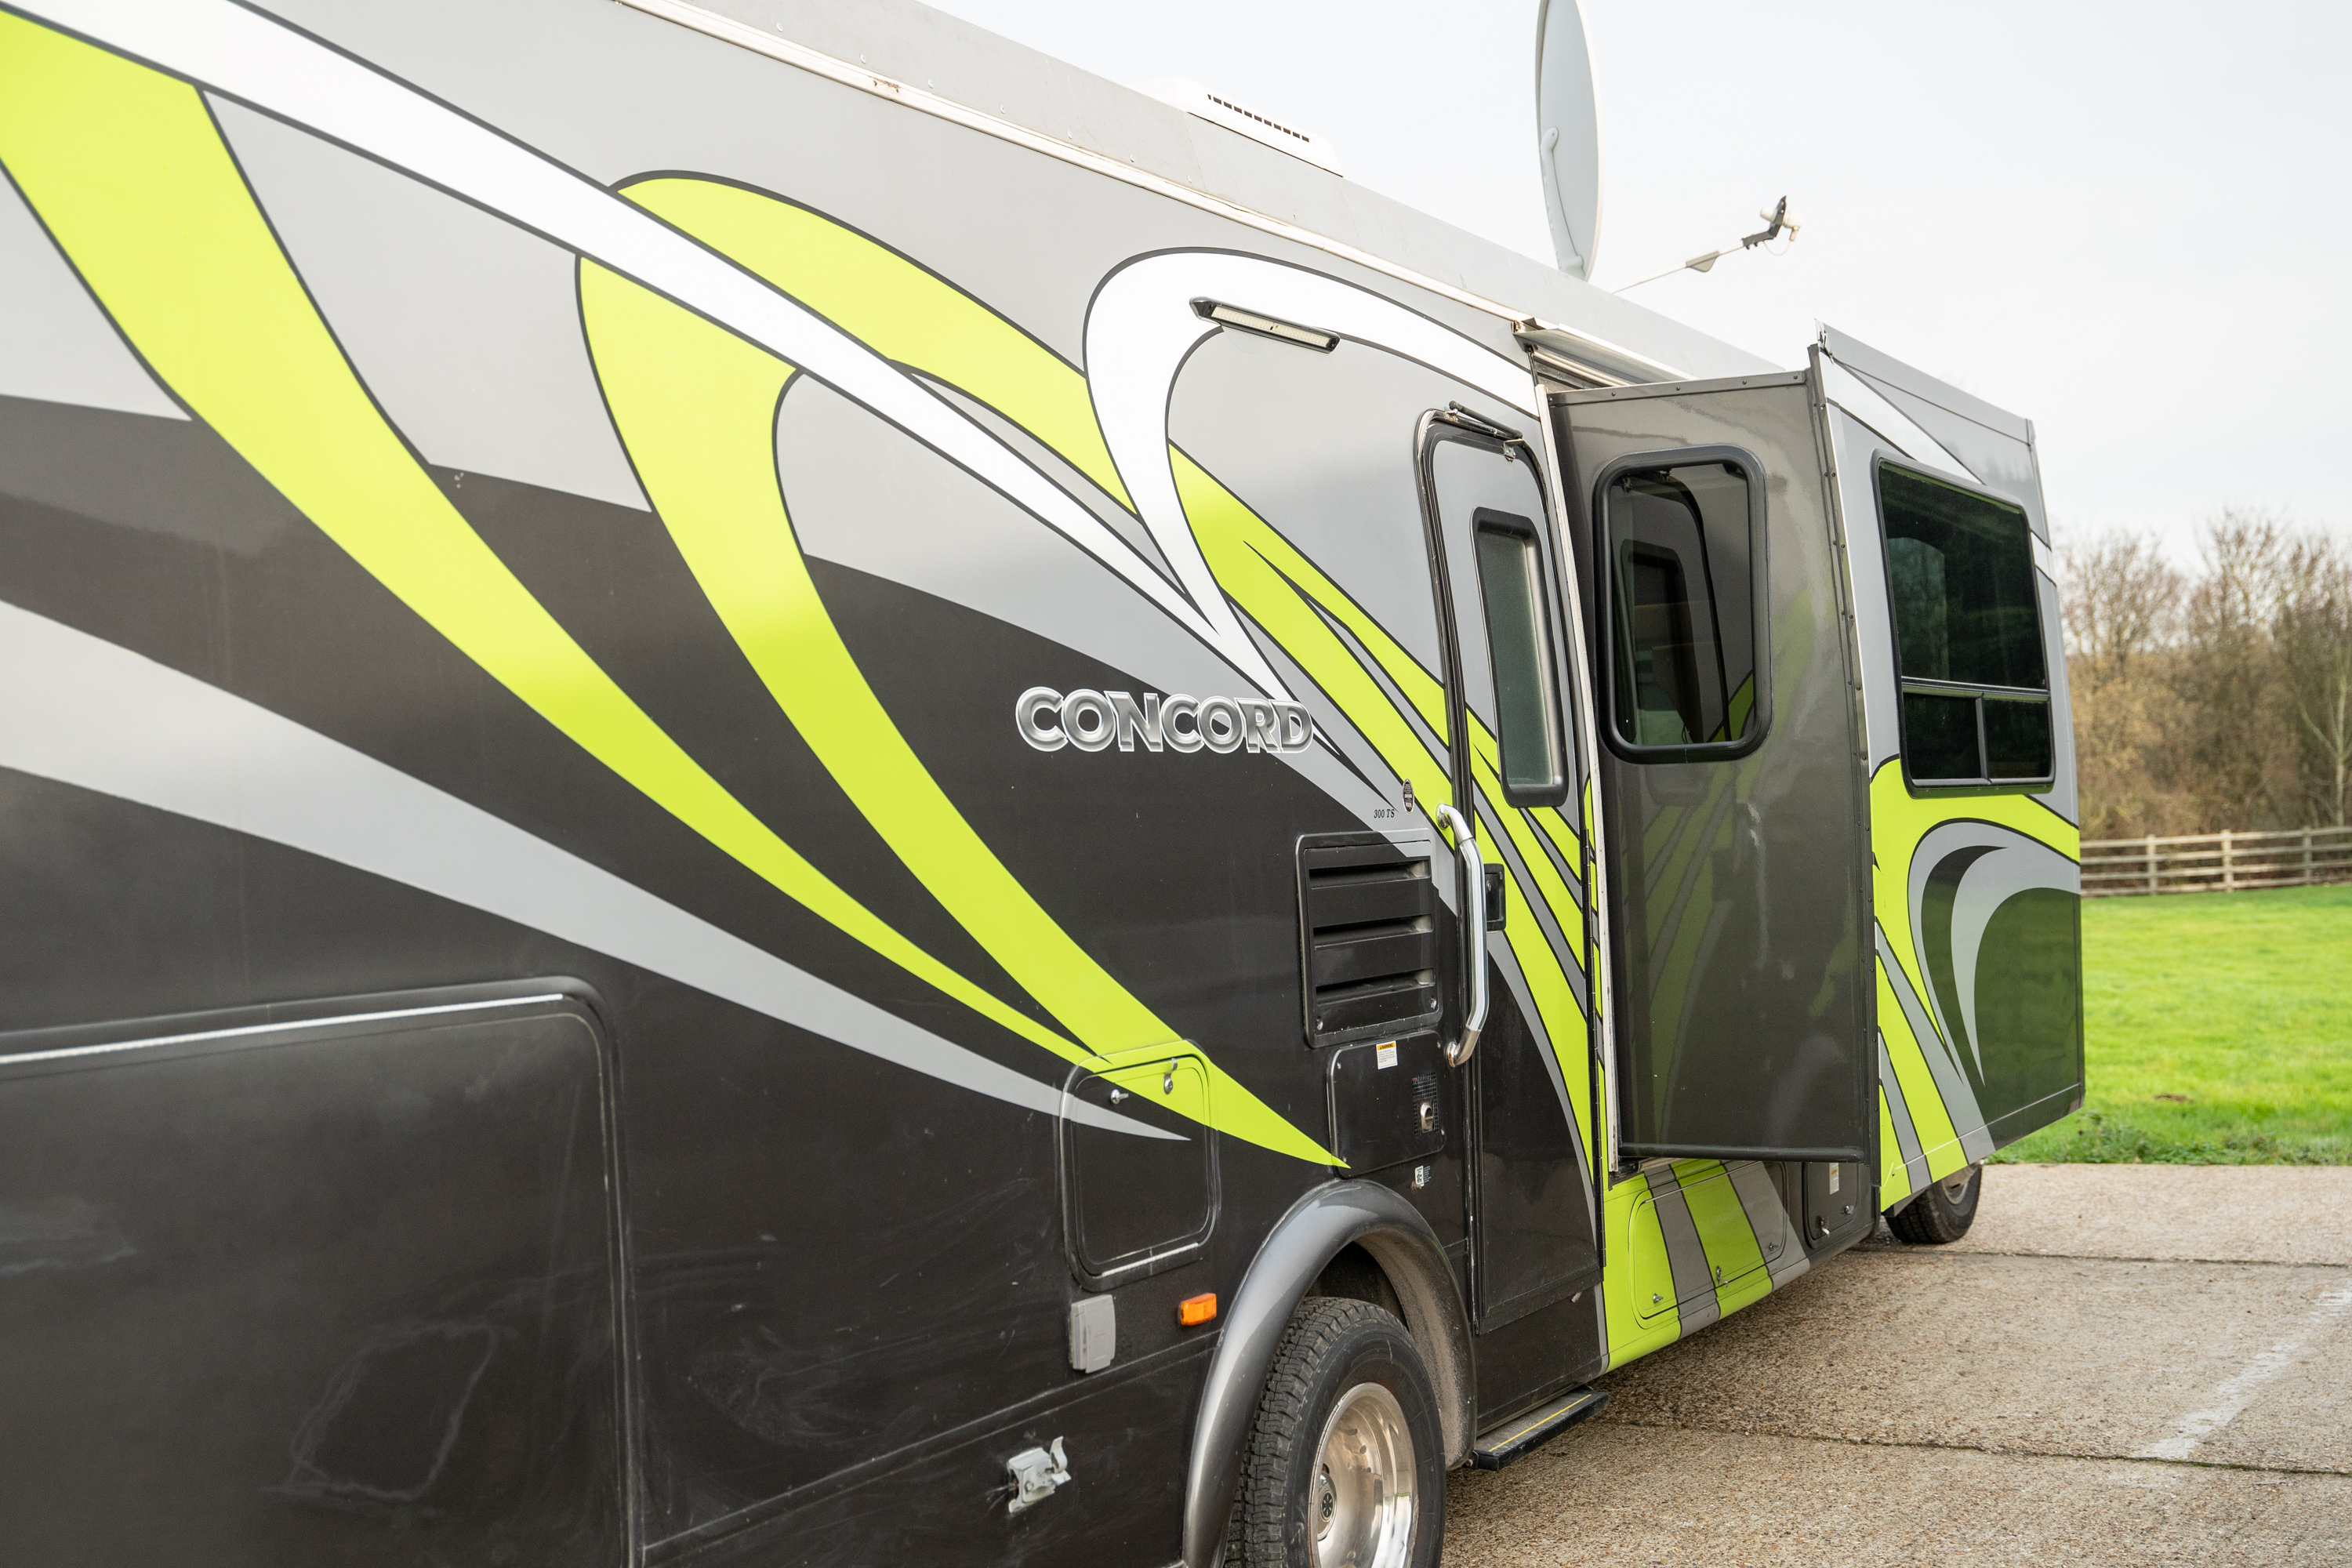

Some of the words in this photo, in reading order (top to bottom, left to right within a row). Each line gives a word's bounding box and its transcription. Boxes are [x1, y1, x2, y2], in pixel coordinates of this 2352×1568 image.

[1015, 686, 1313, 754] CONCORD
[1374, 809, 1385, 818] 300
[1386, 809, 1395, 818] TS
